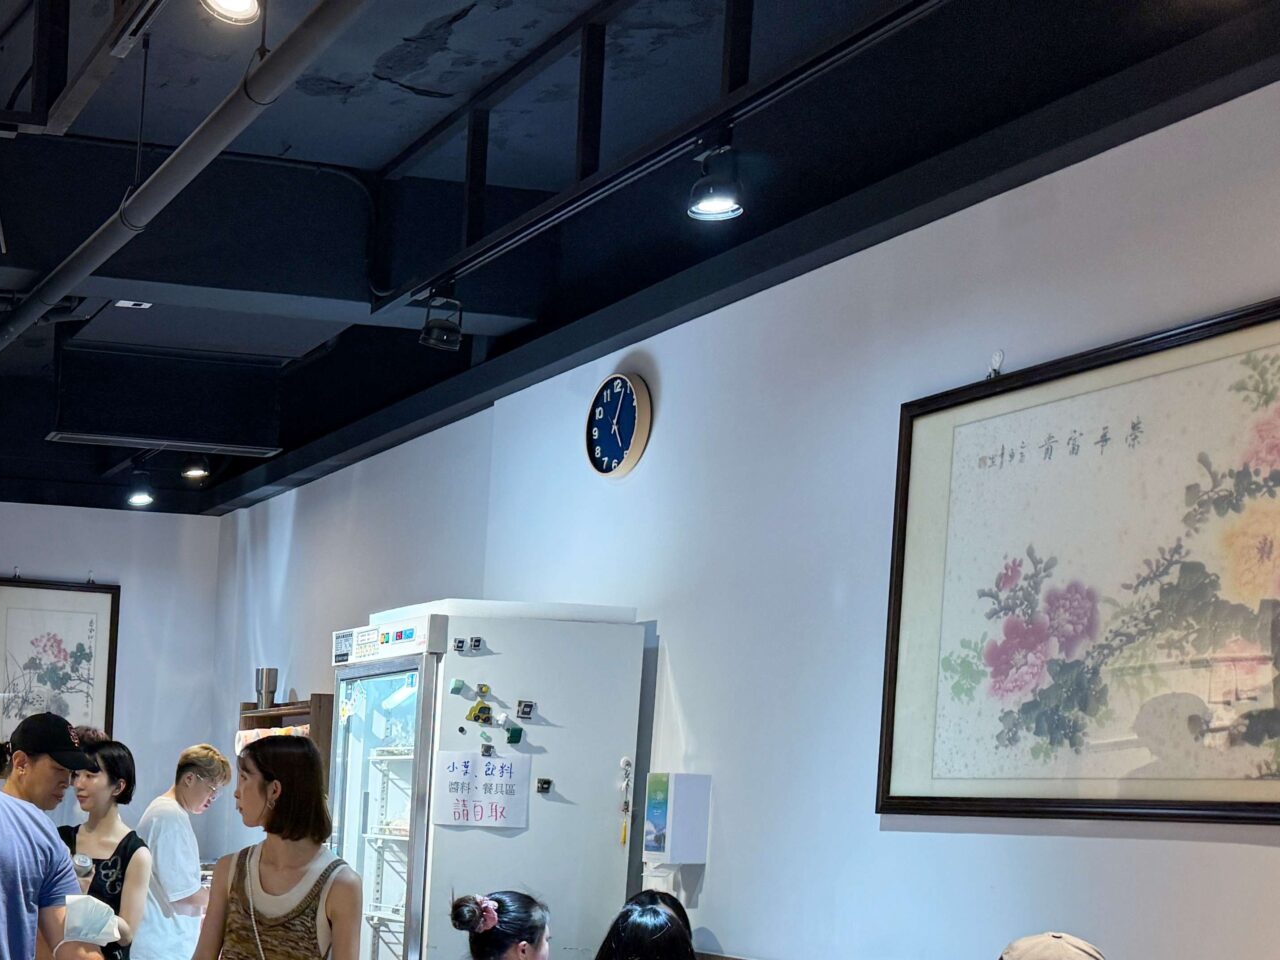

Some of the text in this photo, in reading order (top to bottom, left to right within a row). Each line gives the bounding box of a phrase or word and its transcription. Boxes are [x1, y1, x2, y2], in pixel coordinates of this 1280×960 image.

[613, 379, 622, 393] 12
[603, 389, 611, 403] 11
[595, 406, 603, 419] 10
[592, 427, 599, 439] 9
[594, 446, 601, 458] 8
[601, 457, 608, 469] 7
[448, 780, 516, 796] 醬料、餐具區
